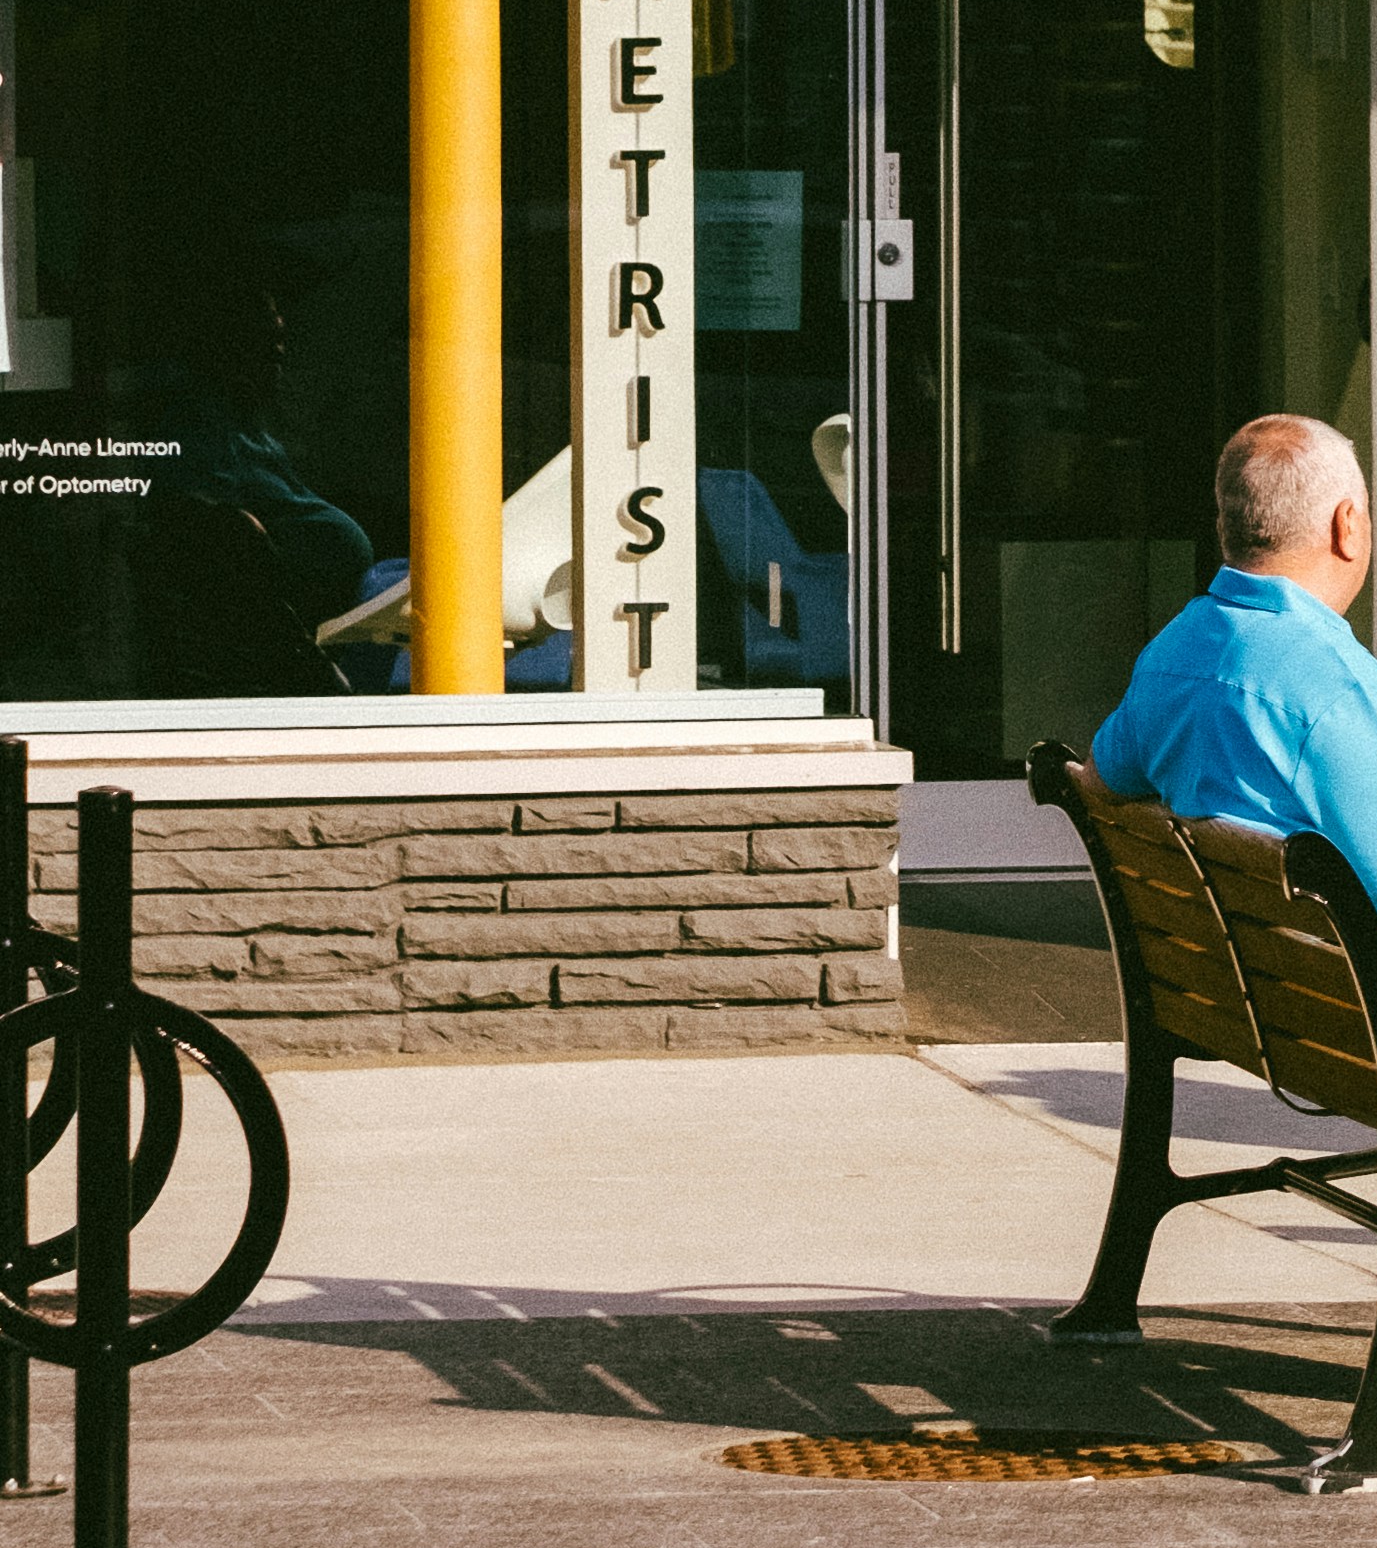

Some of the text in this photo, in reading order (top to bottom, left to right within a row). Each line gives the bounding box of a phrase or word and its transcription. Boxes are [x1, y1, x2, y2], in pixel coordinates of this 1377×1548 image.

[97, 437, 181, 456] Llamzon
[12, 474, 35, 495] of
[39, 475, 151, 498] Optometry
